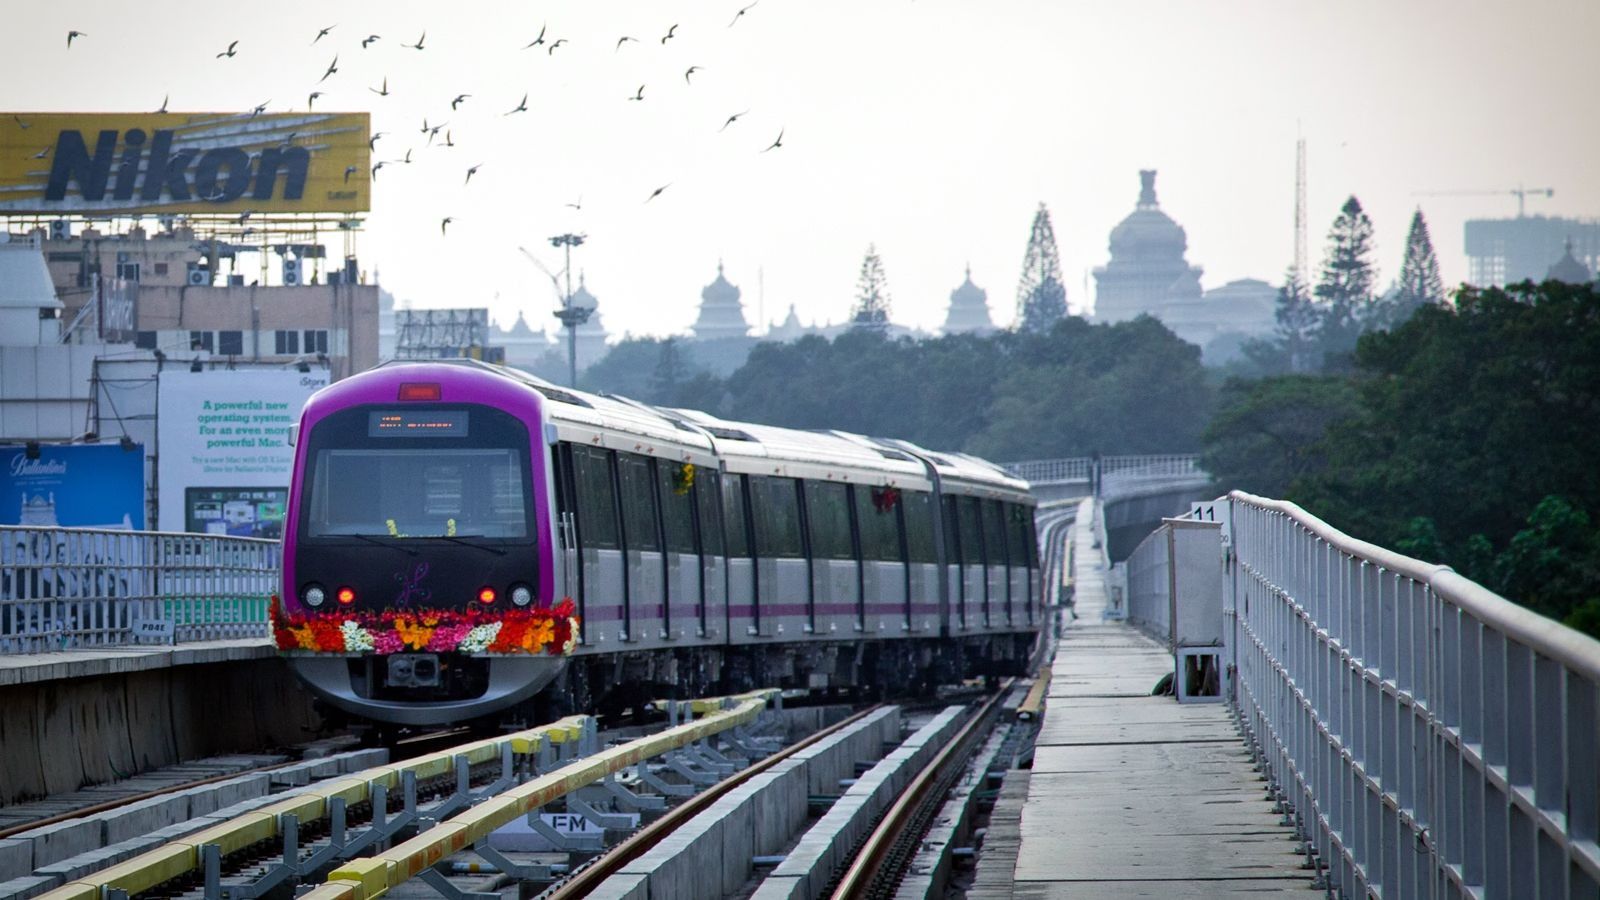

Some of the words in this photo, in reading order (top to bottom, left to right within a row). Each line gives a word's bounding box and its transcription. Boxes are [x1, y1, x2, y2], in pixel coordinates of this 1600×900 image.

[45, 128, 310, 202] Nikon
[203, 400, 212, 410] A
[214, 401, 263, 411] powerful
[266, 402, 288, 410] new
[197, 413, 250, 424] operating
[199, 425, 216, 435] For
[220, 427, 232, 435] an
[235, 427, 261, 435] even
[207, 438, 255, 449] powerful
[258, 438, 285, 447] Mac.
[1194, 506, 1214, 521] 11
